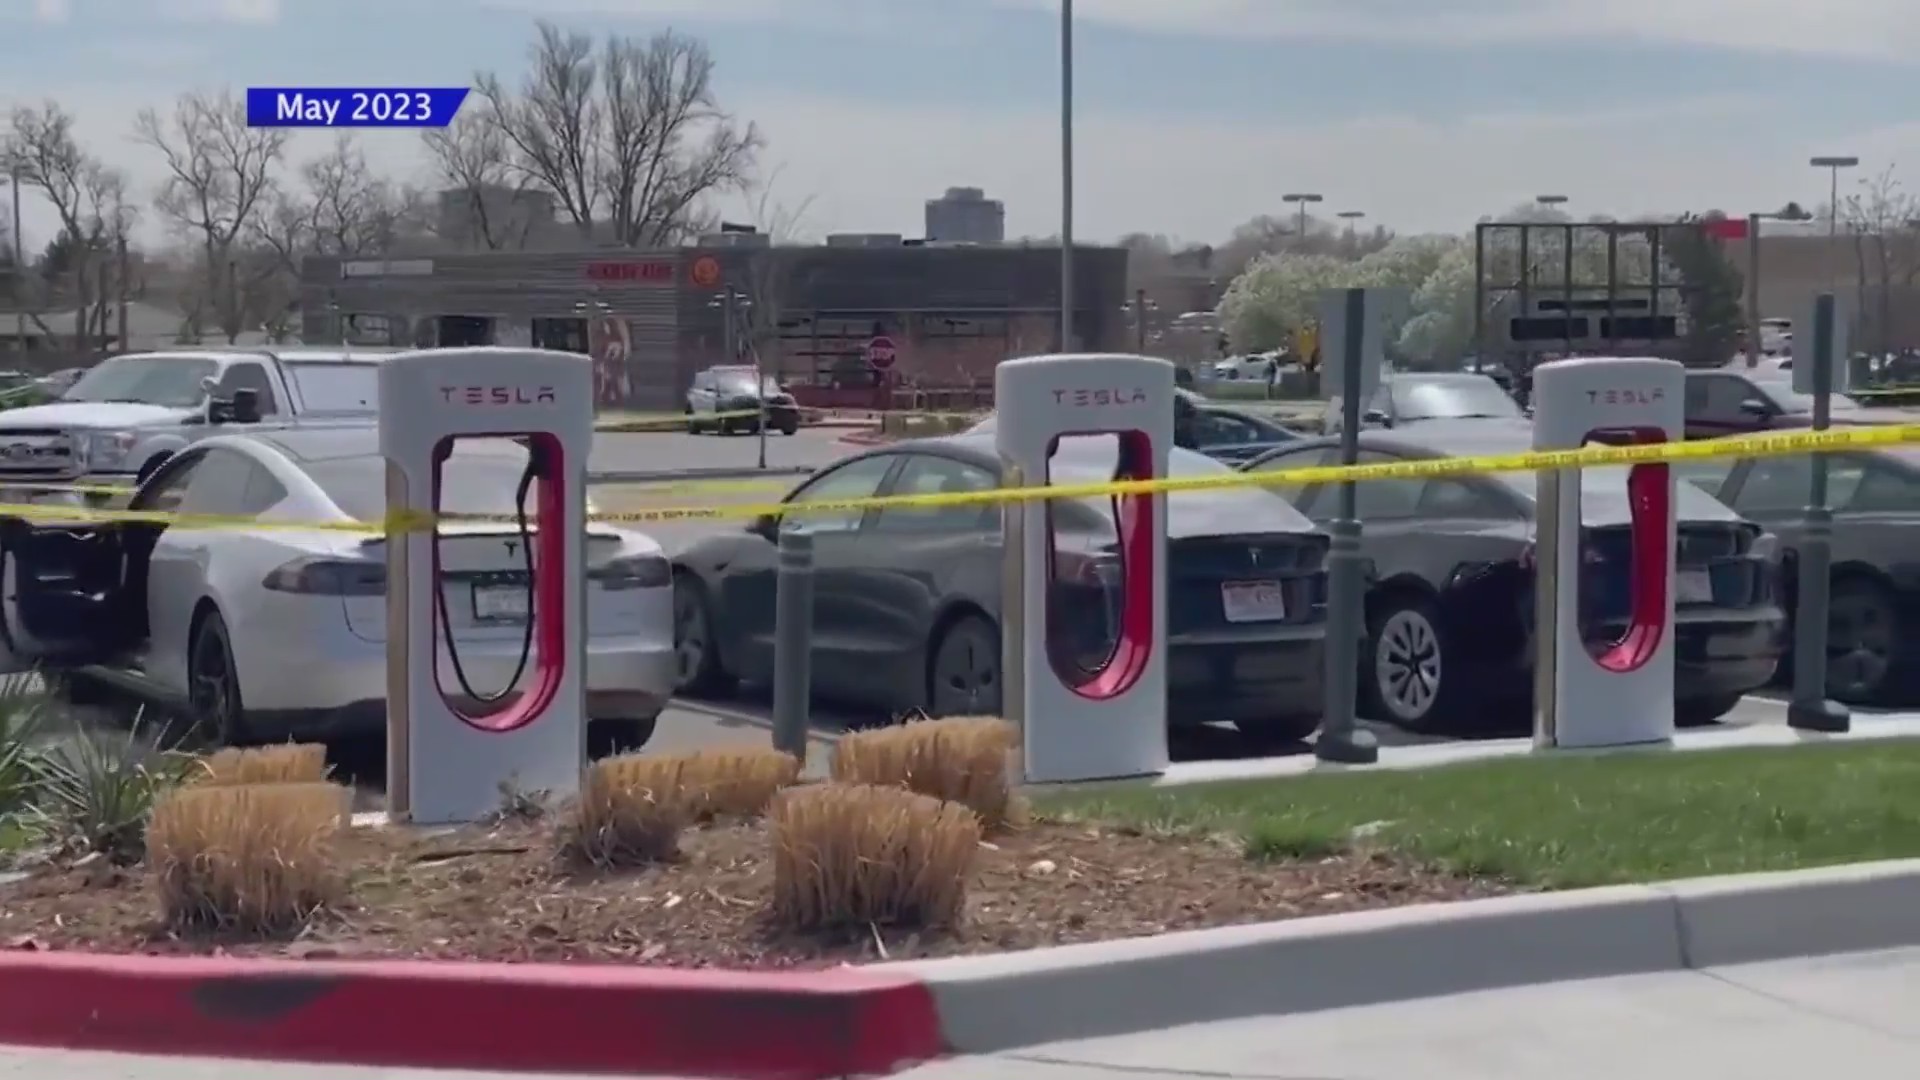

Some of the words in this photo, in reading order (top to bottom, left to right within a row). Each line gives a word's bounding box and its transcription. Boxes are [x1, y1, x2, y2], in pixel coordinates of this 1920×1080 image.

[440, 386, 556, 404] TESLA
[1051, 387, 1147, 406] TESLA
[1585, 387, 1665, 405] TESLA
